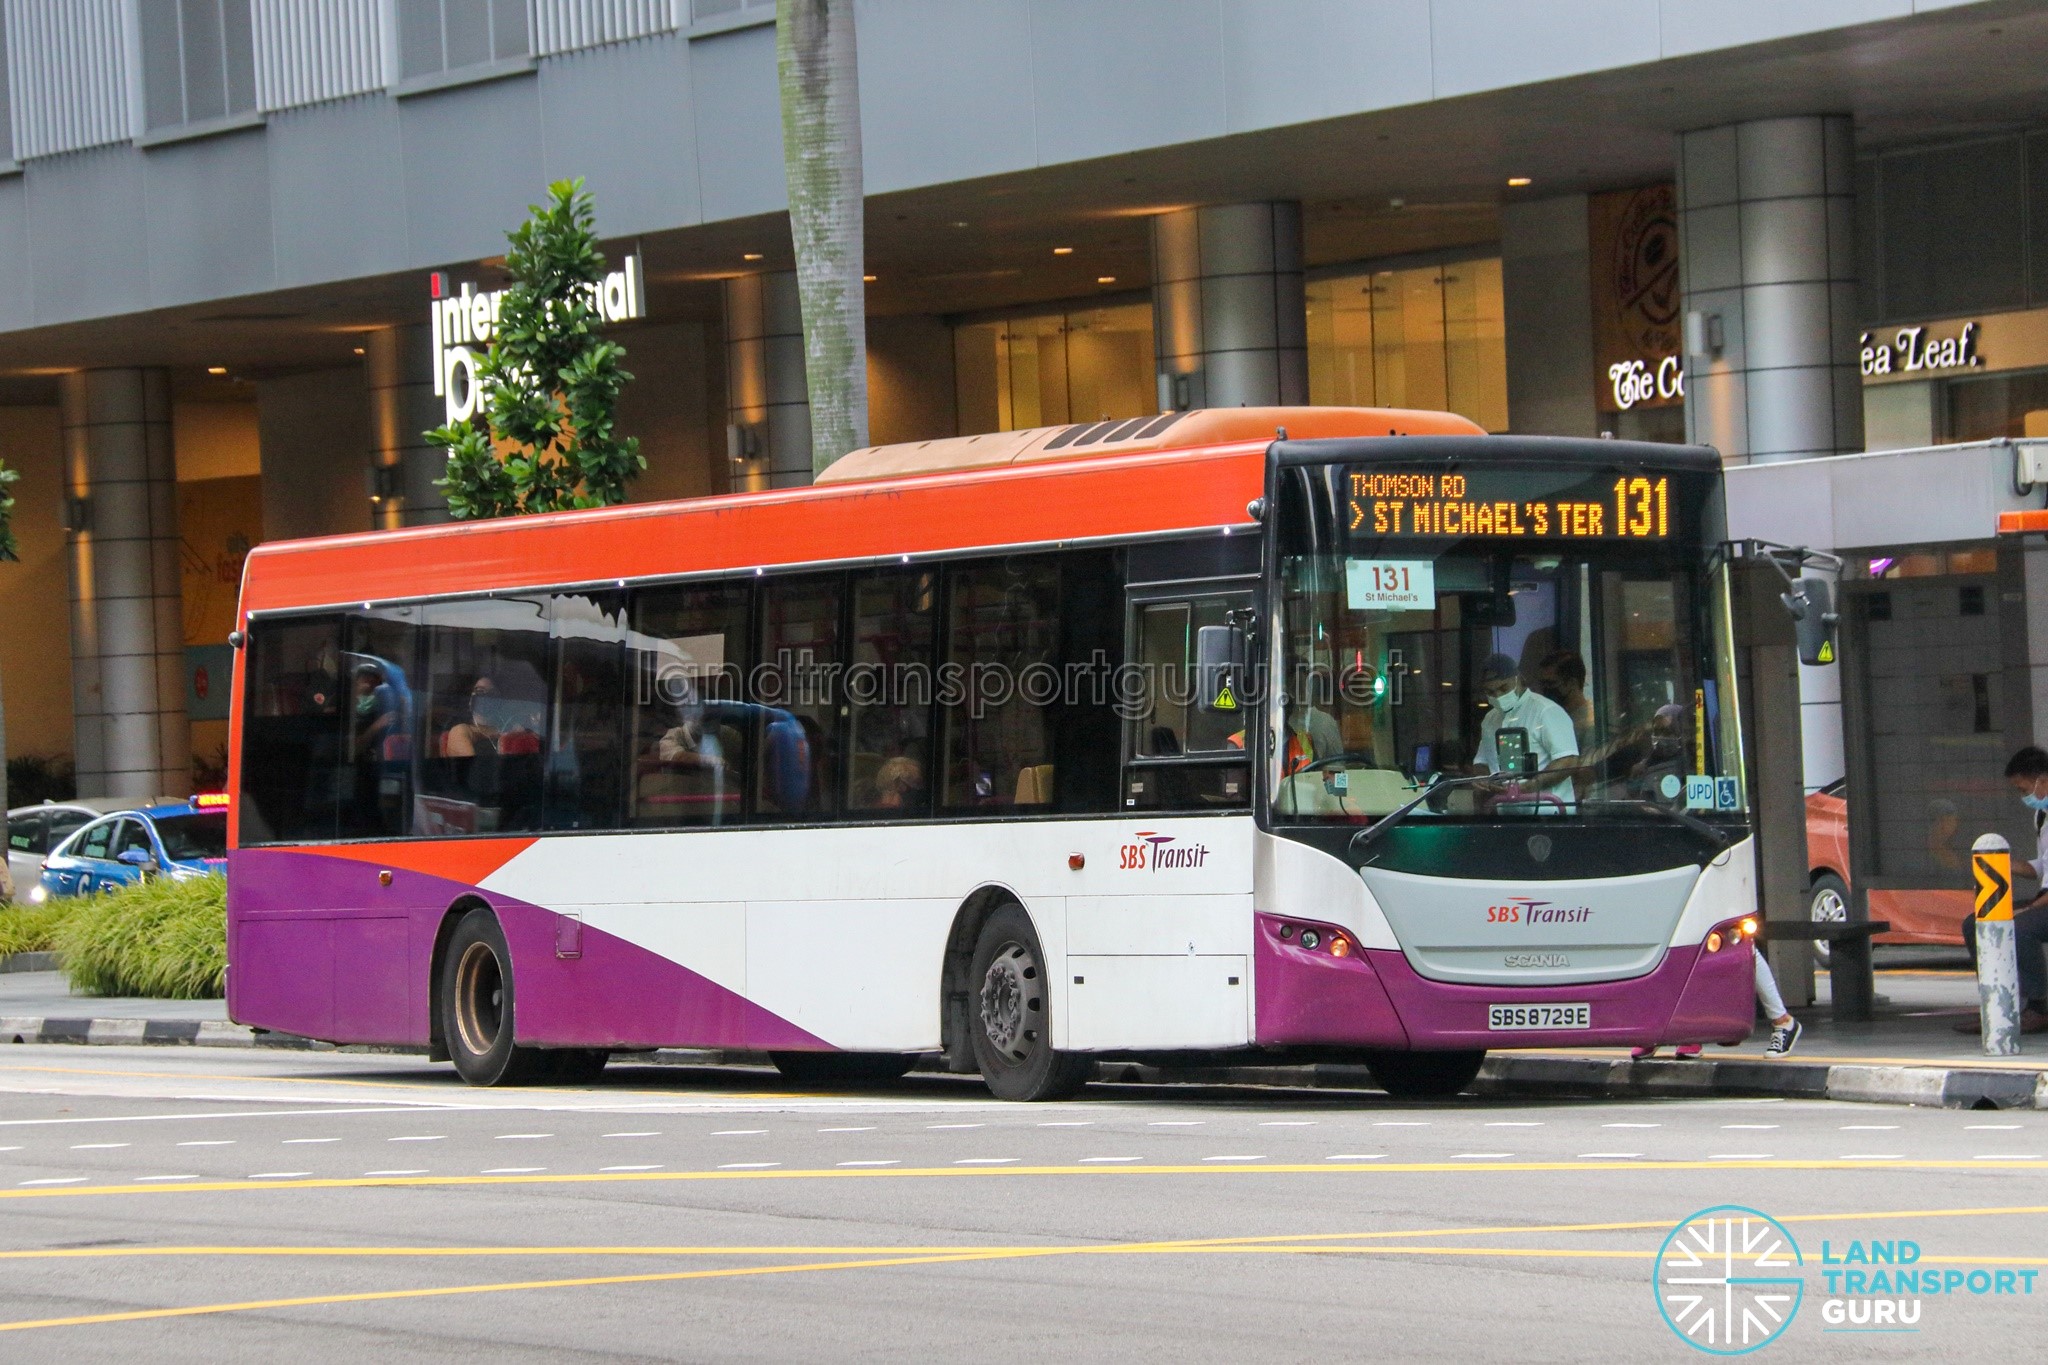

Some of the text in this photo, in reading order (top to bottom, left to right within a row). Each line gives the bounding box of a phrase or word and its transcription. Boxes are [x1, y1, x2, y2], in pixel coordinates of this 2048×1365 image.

[1860, 322, 1977, 375] ea Leaf.
[1609, 360, 1653, 409] The
[1350, 474, 1466, 498] THOMSON RD
[1374, 502, 1603, 535] ST MICHAEL'S TER
[1613, 478, 1668, 537] 131
[1371, 566, 1411, 592] 131
[1365, 592, 1419, 602] St Michael's
[1688, 784, 1713, 800] UPD
[1119, 836, 1210, 874] SBS Transit
[1487, 901, 1596, 926] SBS Transit
[1505, 954, 1571, 968] SCANIA
[1491, 1007, 1588, 1026] SBS8729E
